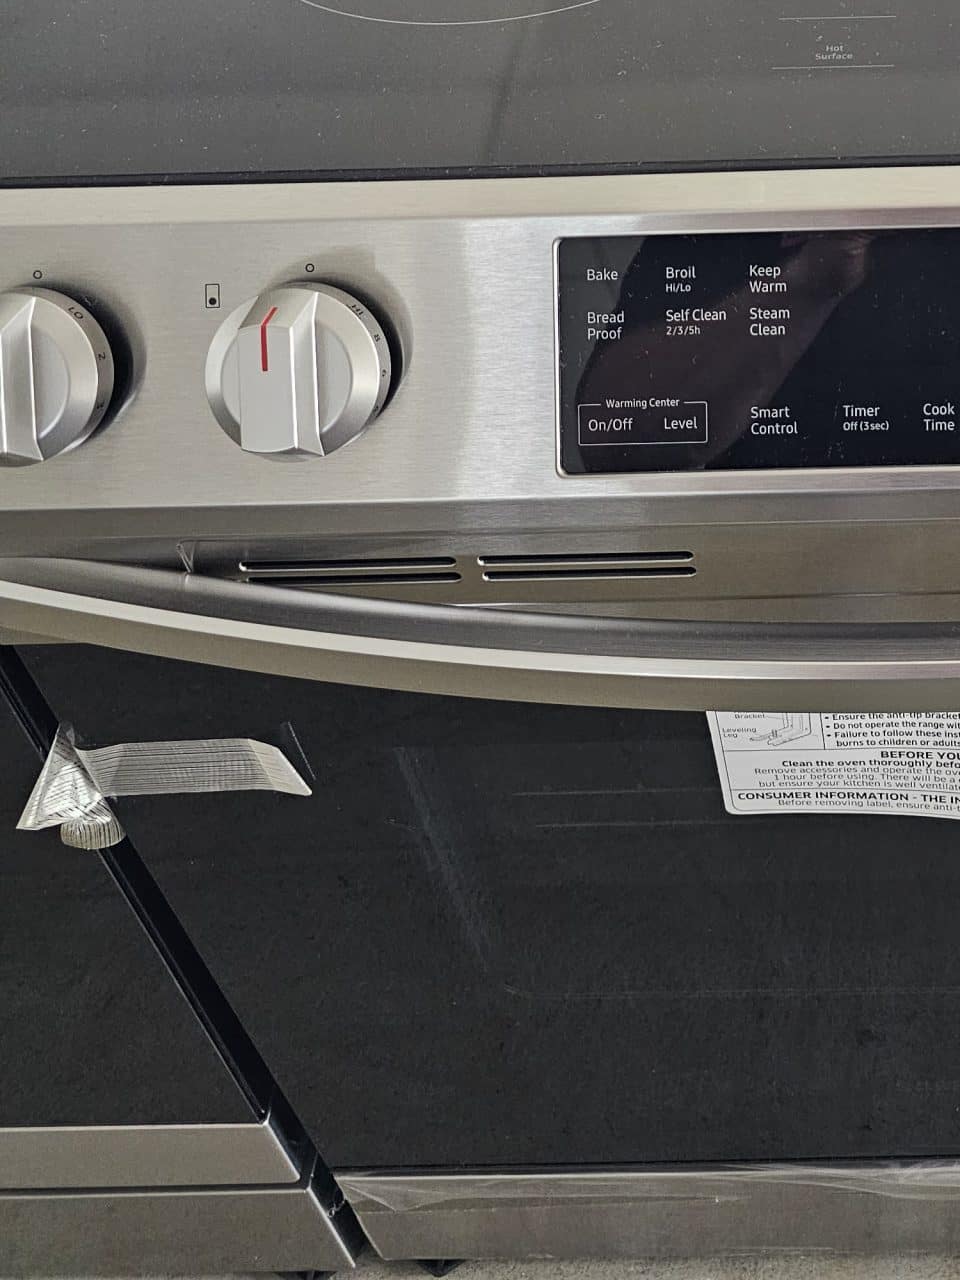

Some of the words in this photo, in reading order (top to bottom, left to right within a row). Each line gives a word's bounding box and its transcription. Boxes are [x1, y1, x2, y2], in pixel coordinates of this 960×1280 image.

[816, 52, 854, 60] Surface
[587, 268, 618, 281] Bake
[666, 266, 696, 280] Broil
[750, 264, 782, 279] Keep
[666, 283, 692, 293] Hi/Lo
[750, 281, 788, 293] Warm
[588, 310, 625, 324] Bread
[666, 308, 690, 322] Self
[692, 308, 727, 322] Clean
[750, 307, 790, 320] Steam
[588, 326, 622, 340] Proof
[666, 325, 701, 336] 2/3/5h
[750, 324, 786, 336] Clean
[606, 398, 648, 410] Warming
[650, 398, 680, 408] Center
[923, 402, 956, 416] Cook
[750, 406, 790, 419] Smart
[842, 404, 880, 418] Timer
[588, 418, 634, 432] On/Off
[664, 417, 698, 430] Level
[750, 422, 798, 435] Control
[842, 420, 858, 431] Off
[923, 418, 956, 431] Time
[864, 722, 900, 730] operate
[836, 740, 864, 748] burns
[880, 750, 934, 760] BEFORE
[868, 758, 932, 768] thoroughly
[738, 792, 812, 800] CONSUMER
[815, 792, 909, 801] INFORMATION
[921, 794, 946, 804] THE
